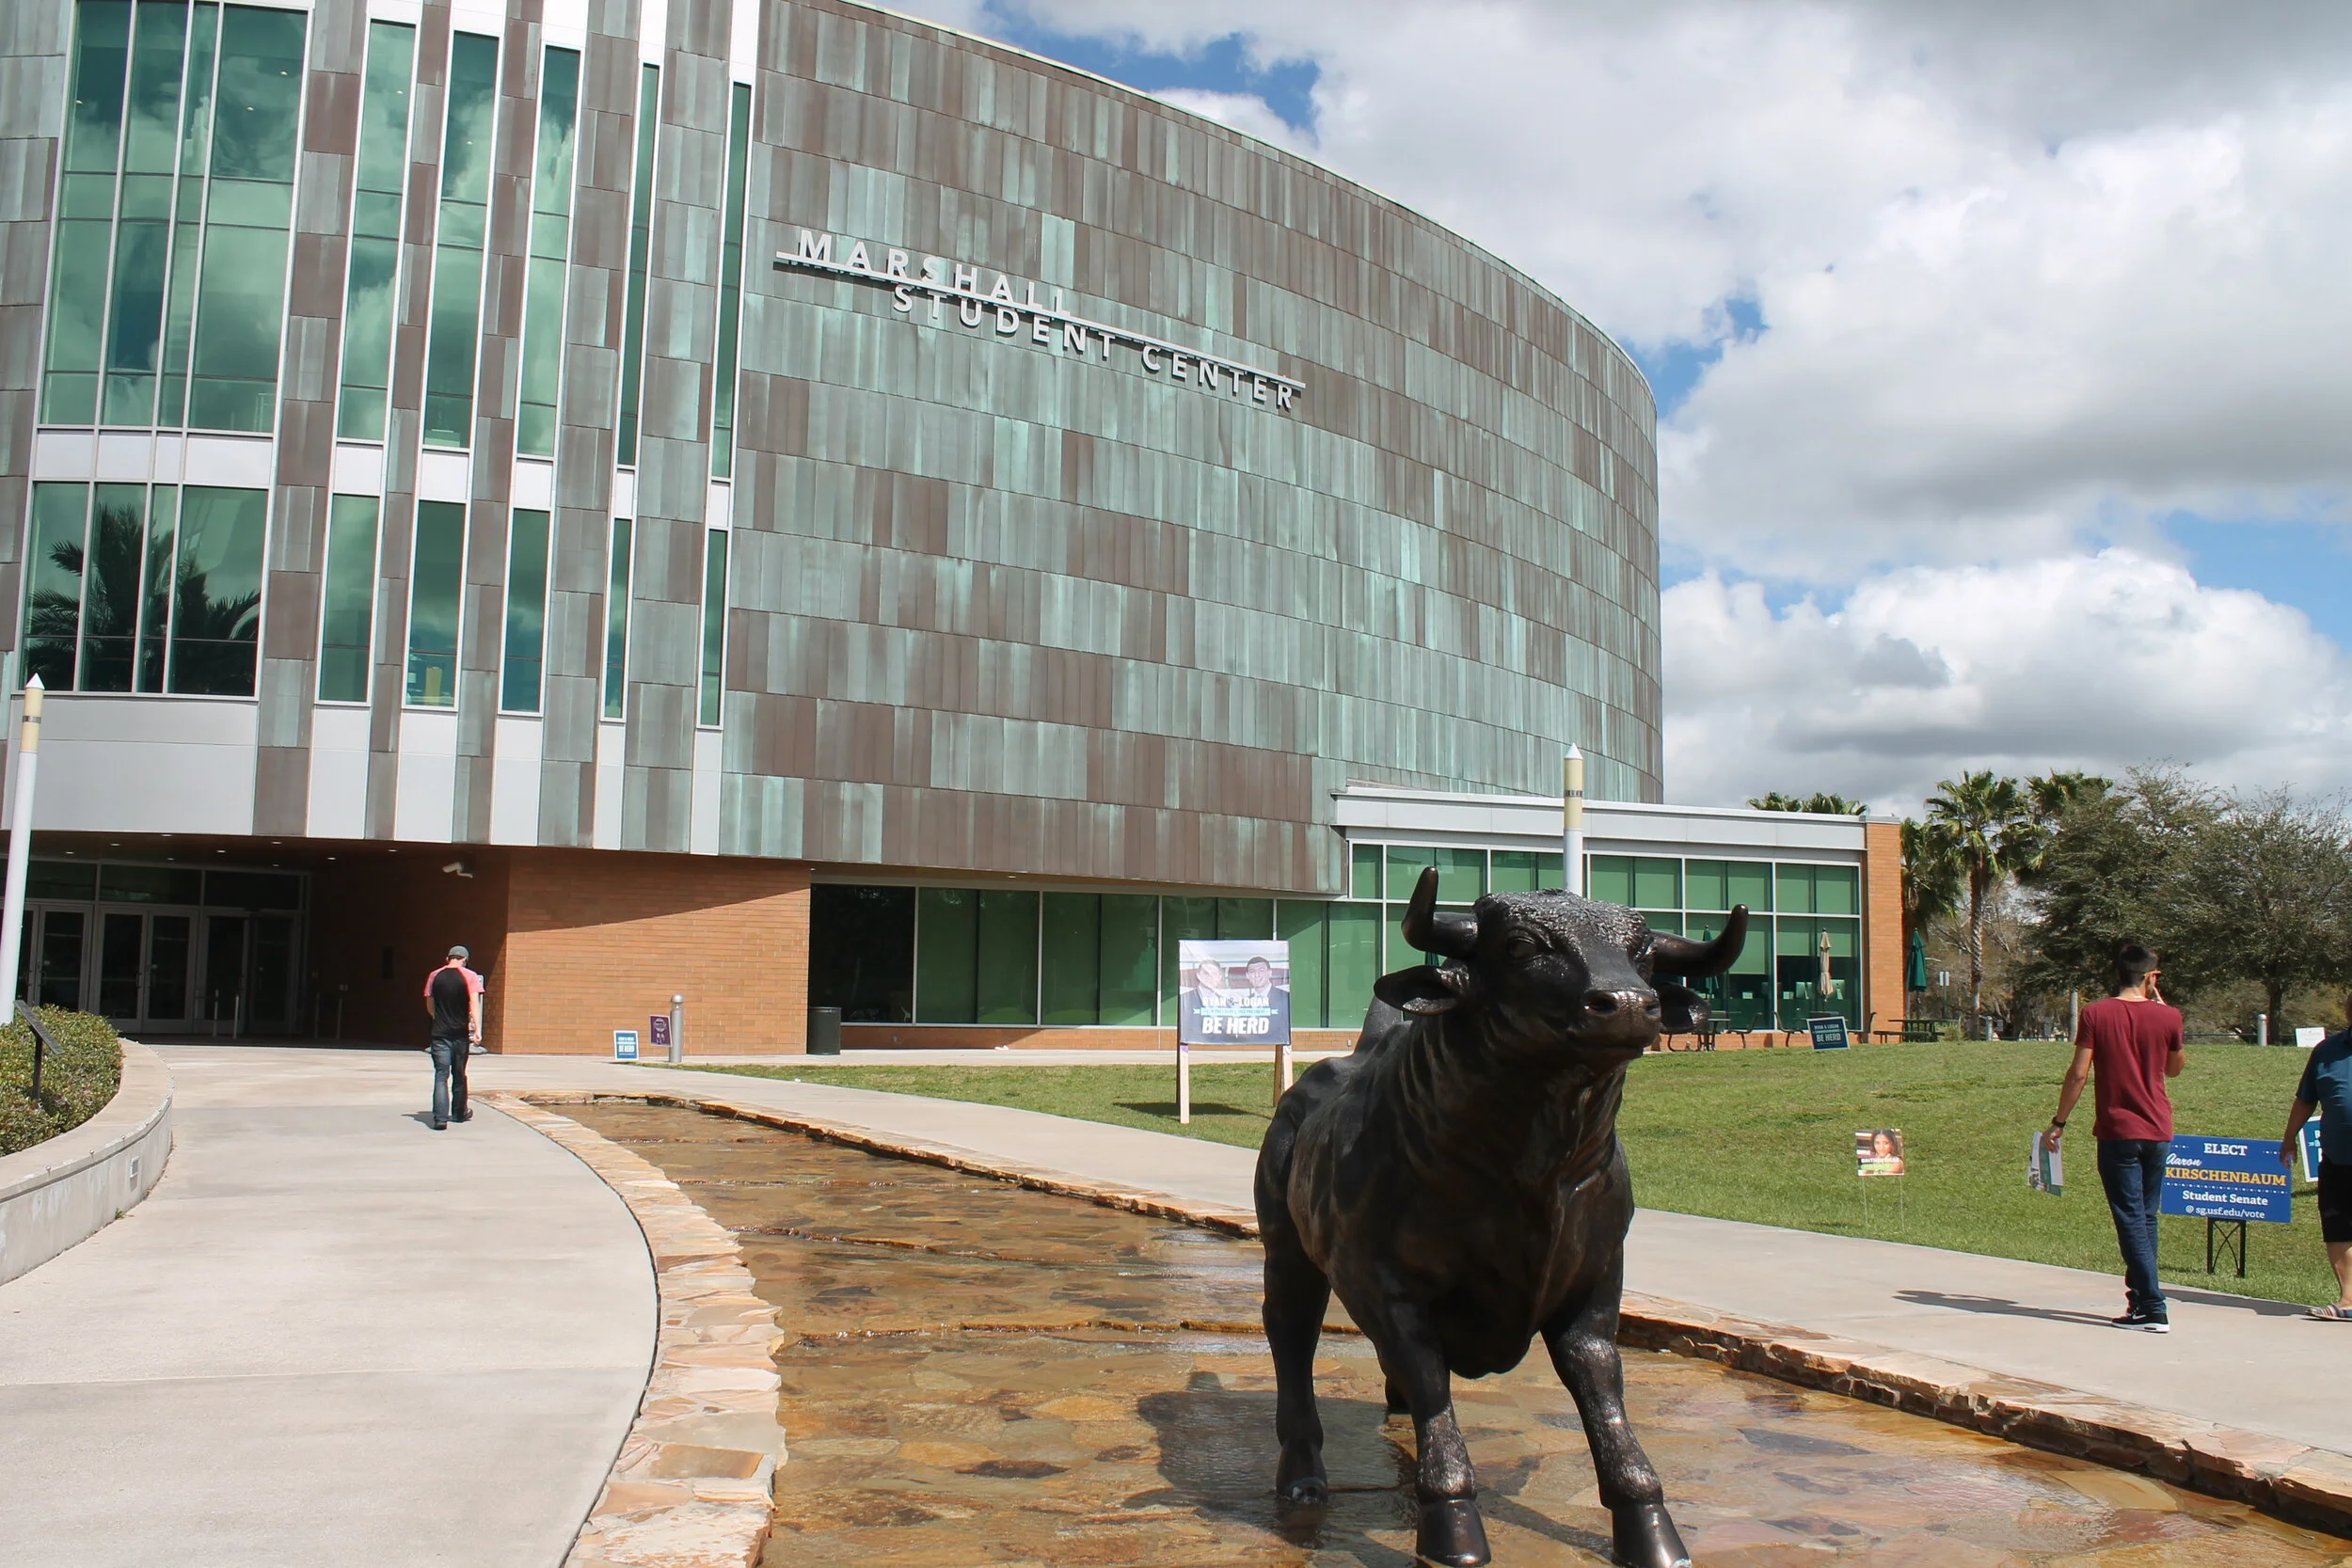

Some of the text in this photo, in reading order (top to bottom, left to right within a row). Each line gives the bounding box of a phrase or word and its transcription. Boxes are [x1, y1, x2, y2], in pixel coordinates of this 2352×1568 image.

[799, 230, 1071, 316] MARSHALL
[892, 283, 1295, 410] STUDENT CENTER
[1202, 1017, 1269, 1035] BE HERD
[1825, 1033, 1841, 1041] HERD
[2203, 1143, 2248, 1156] ELECT
[2166, 1153, 2202, 1166] Aaron
[2165, 1167, 2286, 1186] KIRSCHENBAUM
[2183, 1190, 2268, 1206] Student Senate
[2196, 1207, 2265, 1219] sg.usf.edu/vote
